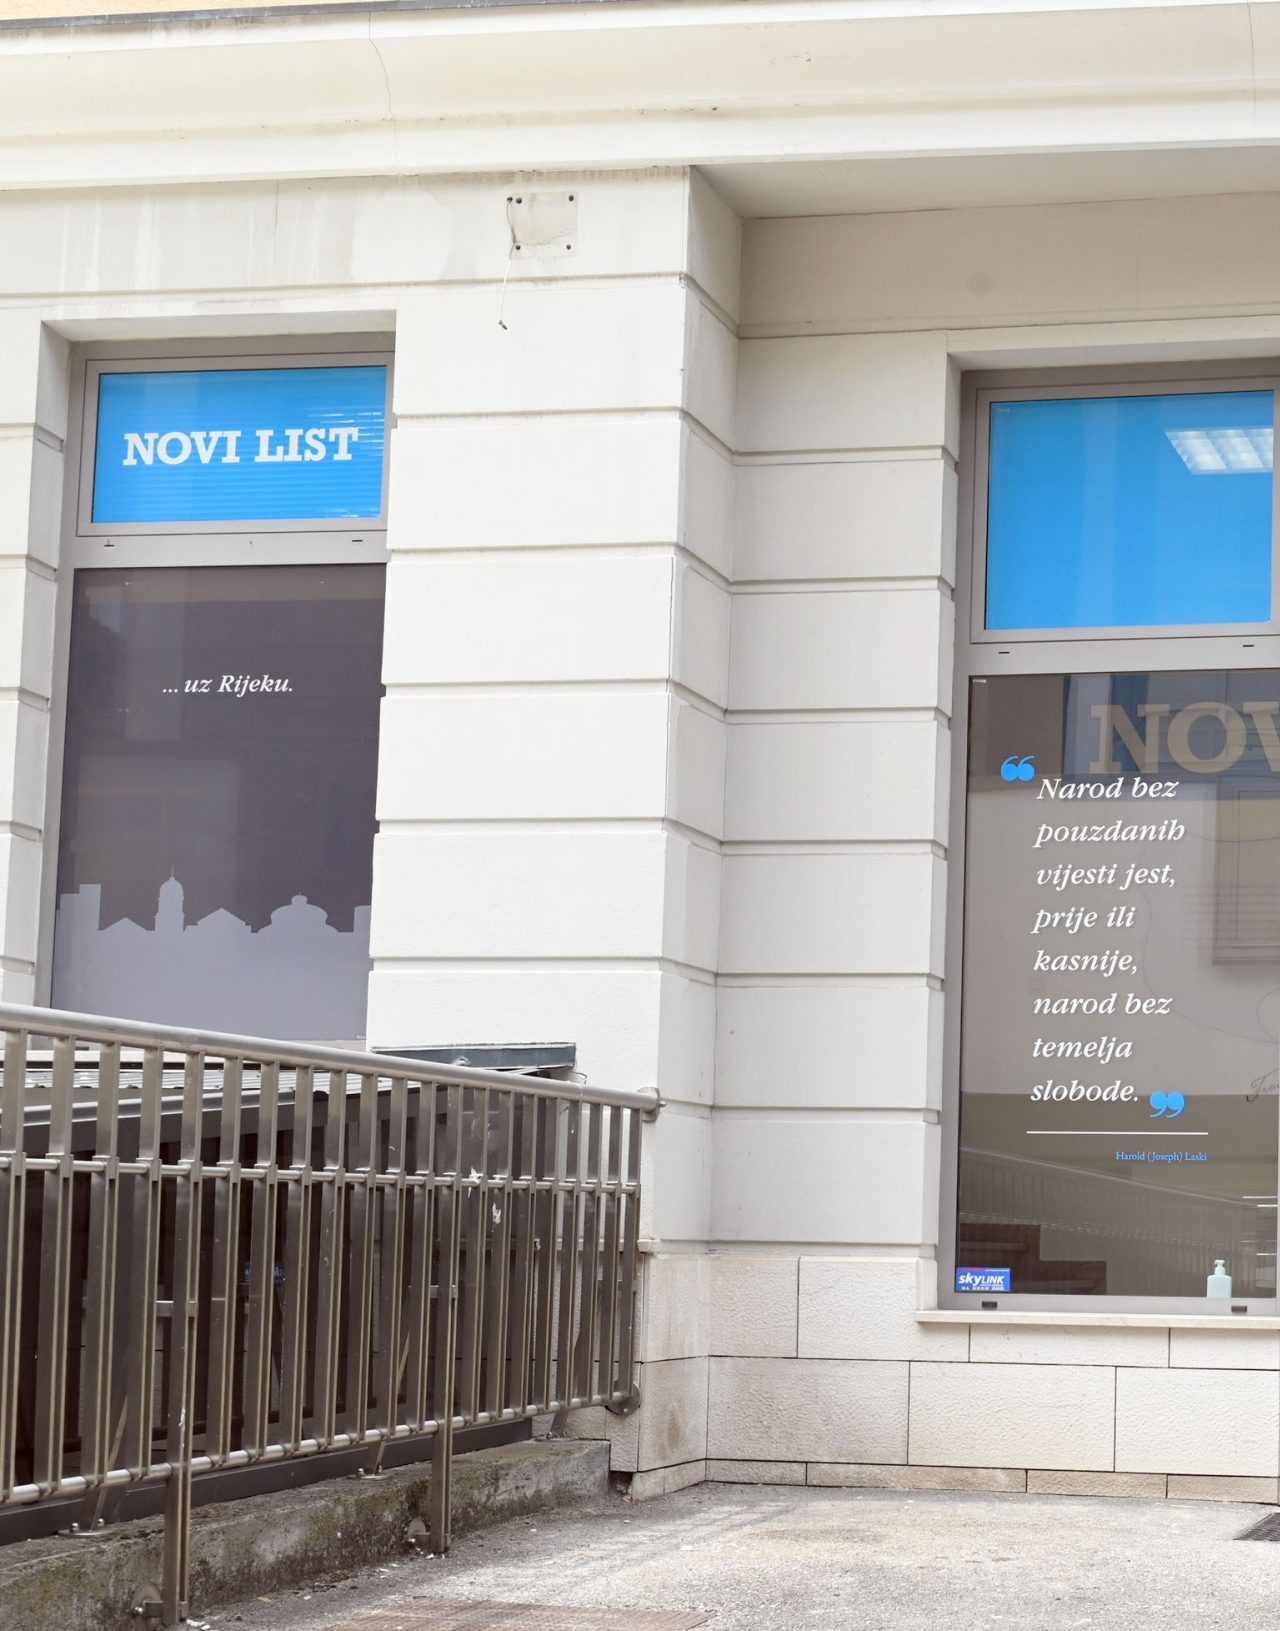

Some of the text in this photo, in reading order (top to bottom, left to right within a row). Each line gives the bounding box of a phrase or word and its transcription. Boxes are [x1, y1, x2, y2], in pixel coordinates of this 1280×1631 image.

[122, 427, 359, 466] NOVI LIST
[217, 674, 293, 698] Rijeku.
[1036, 776, 1180, 800] Narod bez
[1032, 819, 1185, 849] pouzdanih
[1036, 863, 1176, 892] vijesti jest,
[1030, 905, 1136, 935] prije ili
[1033, 949, 1138, 978] kasnije,
[1033, 993, 1173, 1015] narod bez
[1032, 1036, 1133, 1065] temelja
[1030, 1079, 1139, 1102] slobode.
[1115, 1151, 1208, 1163] Harold (Joseph) Laski
